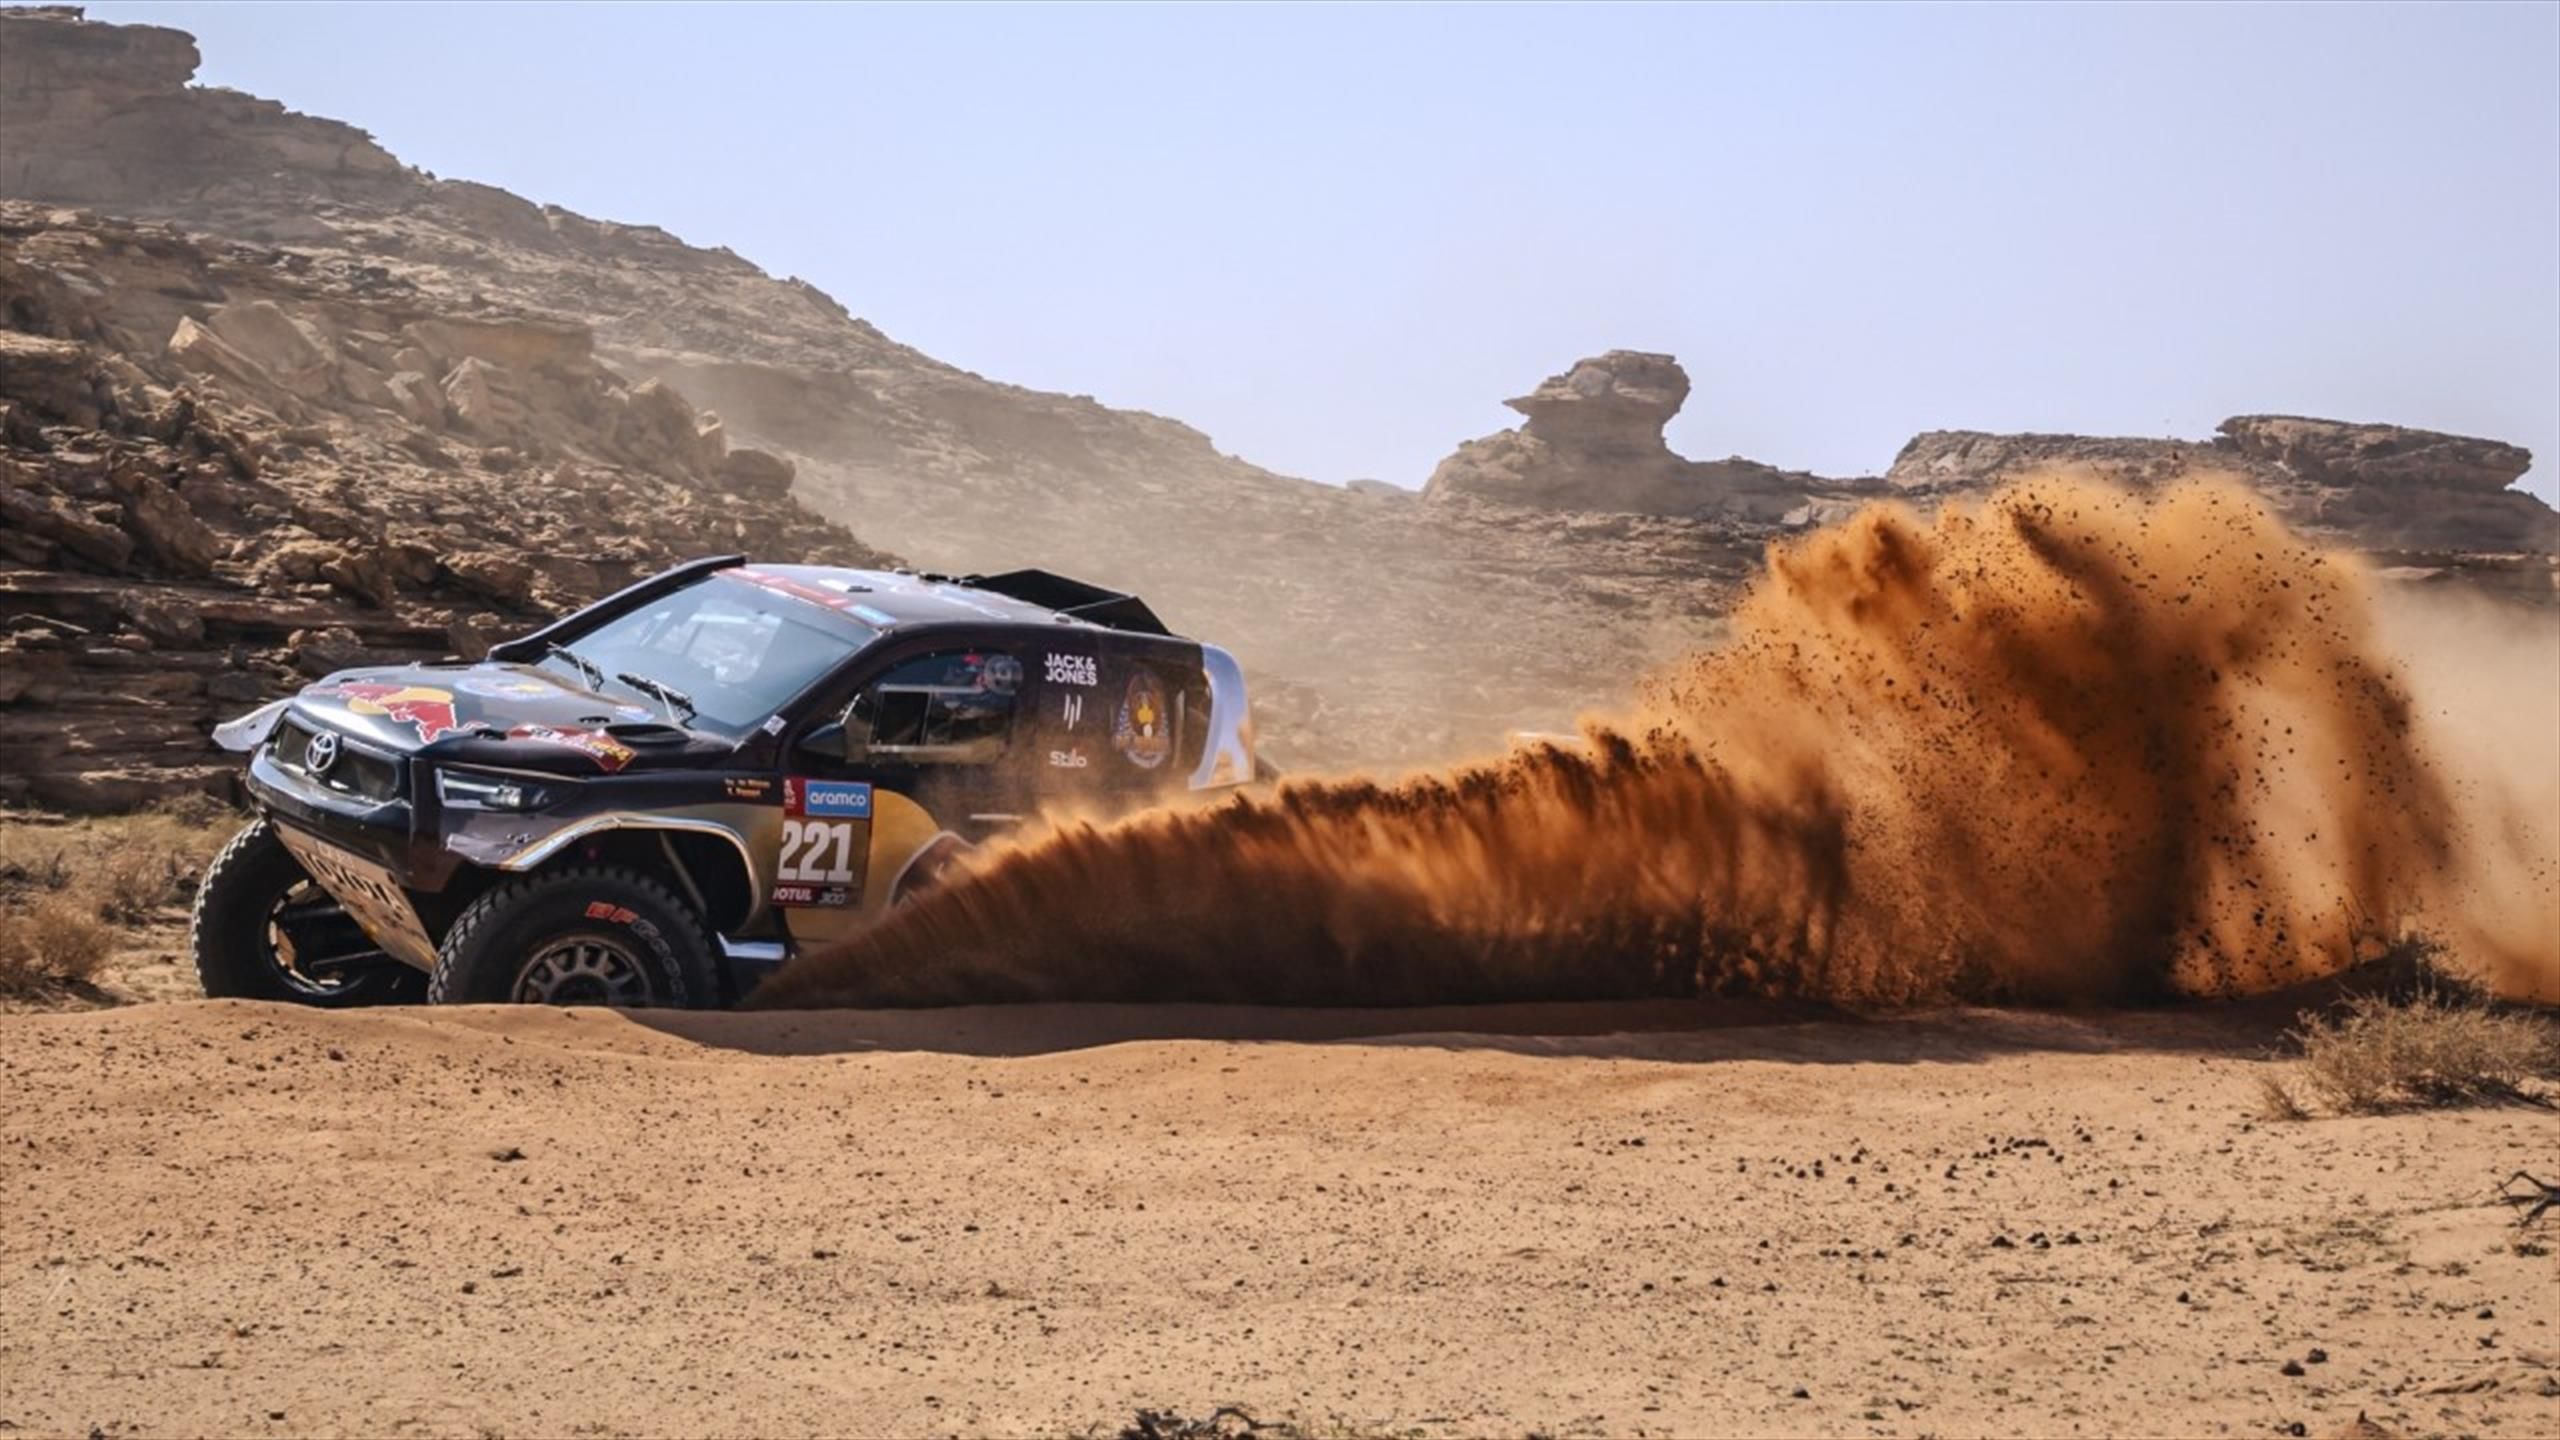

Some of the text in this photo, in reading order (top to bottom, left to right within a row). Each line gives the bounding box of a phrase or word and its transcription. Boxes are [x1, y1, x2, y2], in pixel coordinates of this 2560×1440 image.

[1044, 653, 1096, 672] JACK&
[1045, 667, 1098, 686] JONES
[809, 791, 866, 807] aramco
[777, 819, 853, 882] 221
